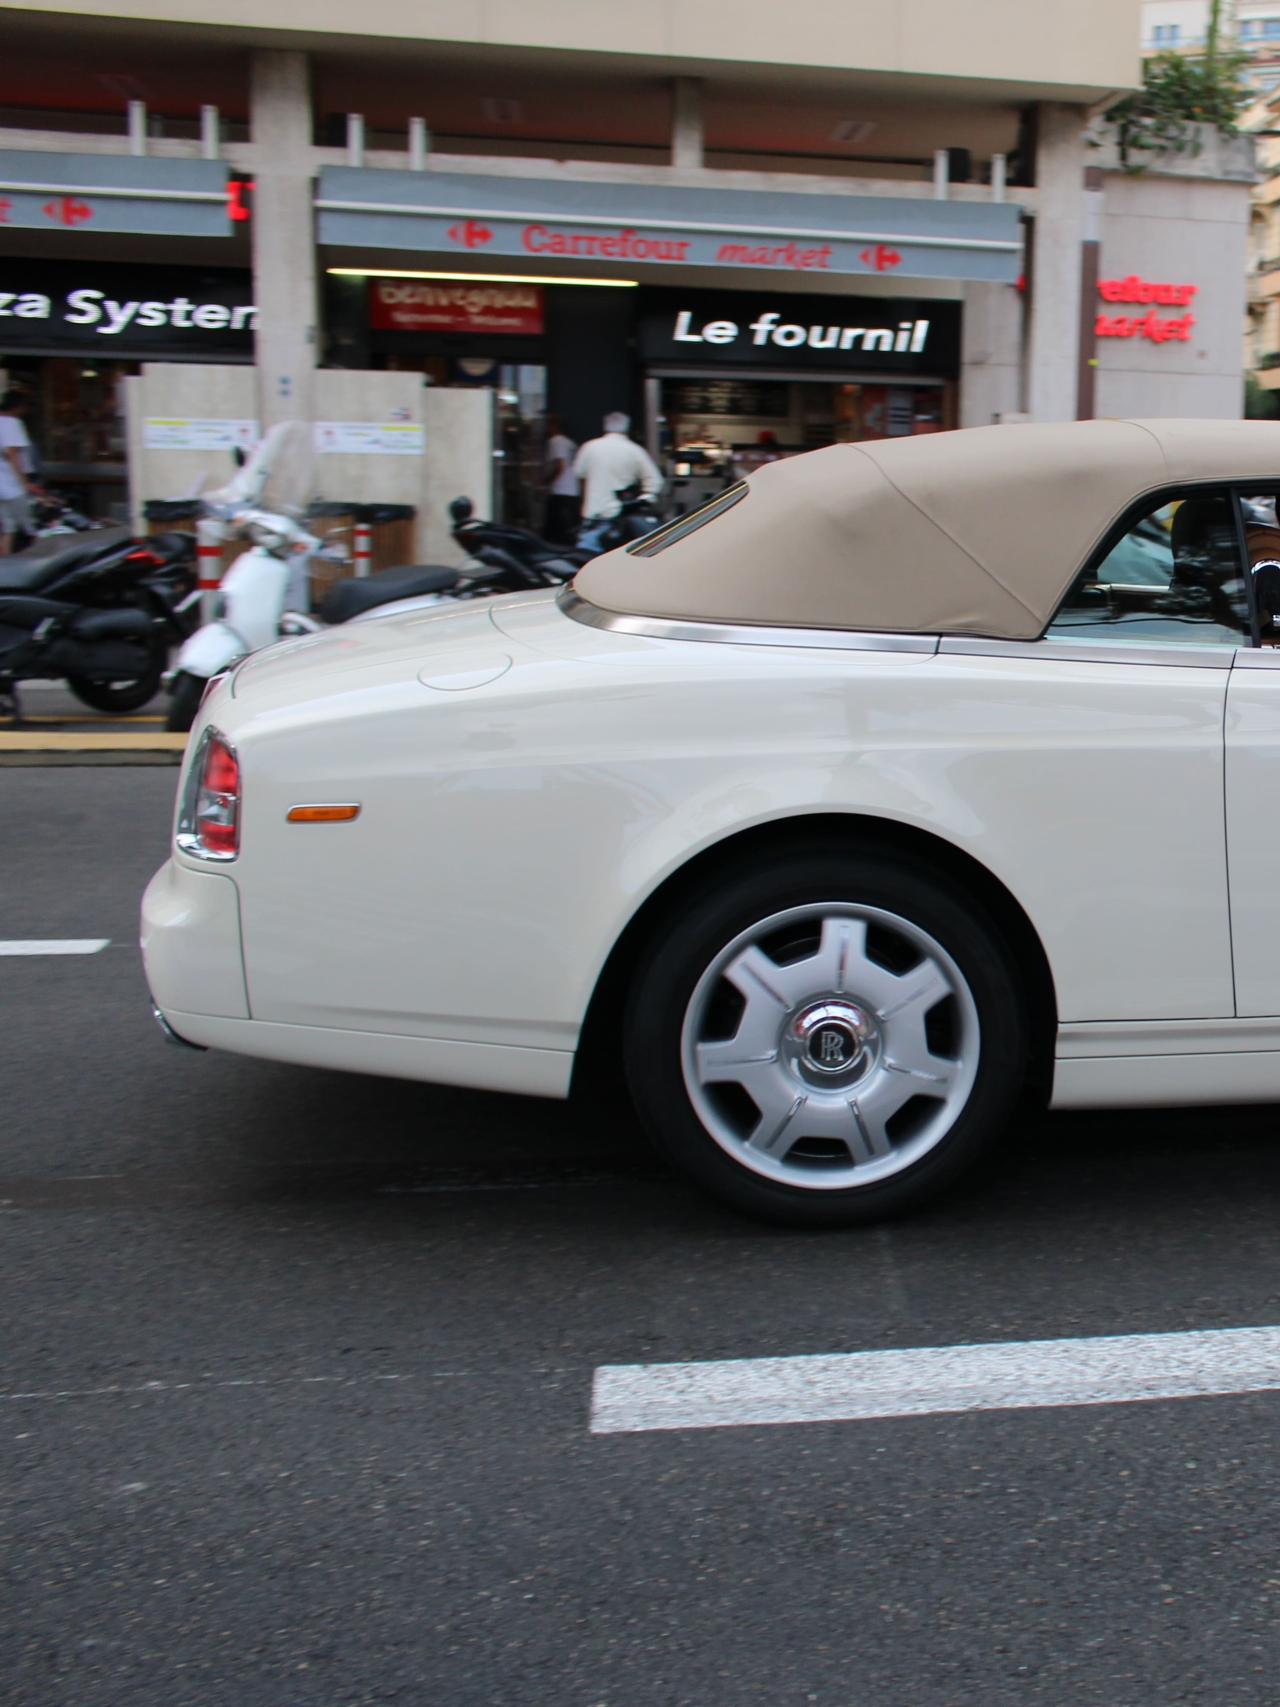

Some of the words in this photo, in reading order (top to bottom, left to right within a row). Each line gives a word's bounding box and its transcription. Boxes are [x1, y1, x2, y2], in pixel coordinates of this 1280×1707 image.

[521, 224, 692, 261] Carrefour
[716, 241, 835, 270] market
[673, 311, 738, 344] Le
[749, 312, 929, 352] fournil
